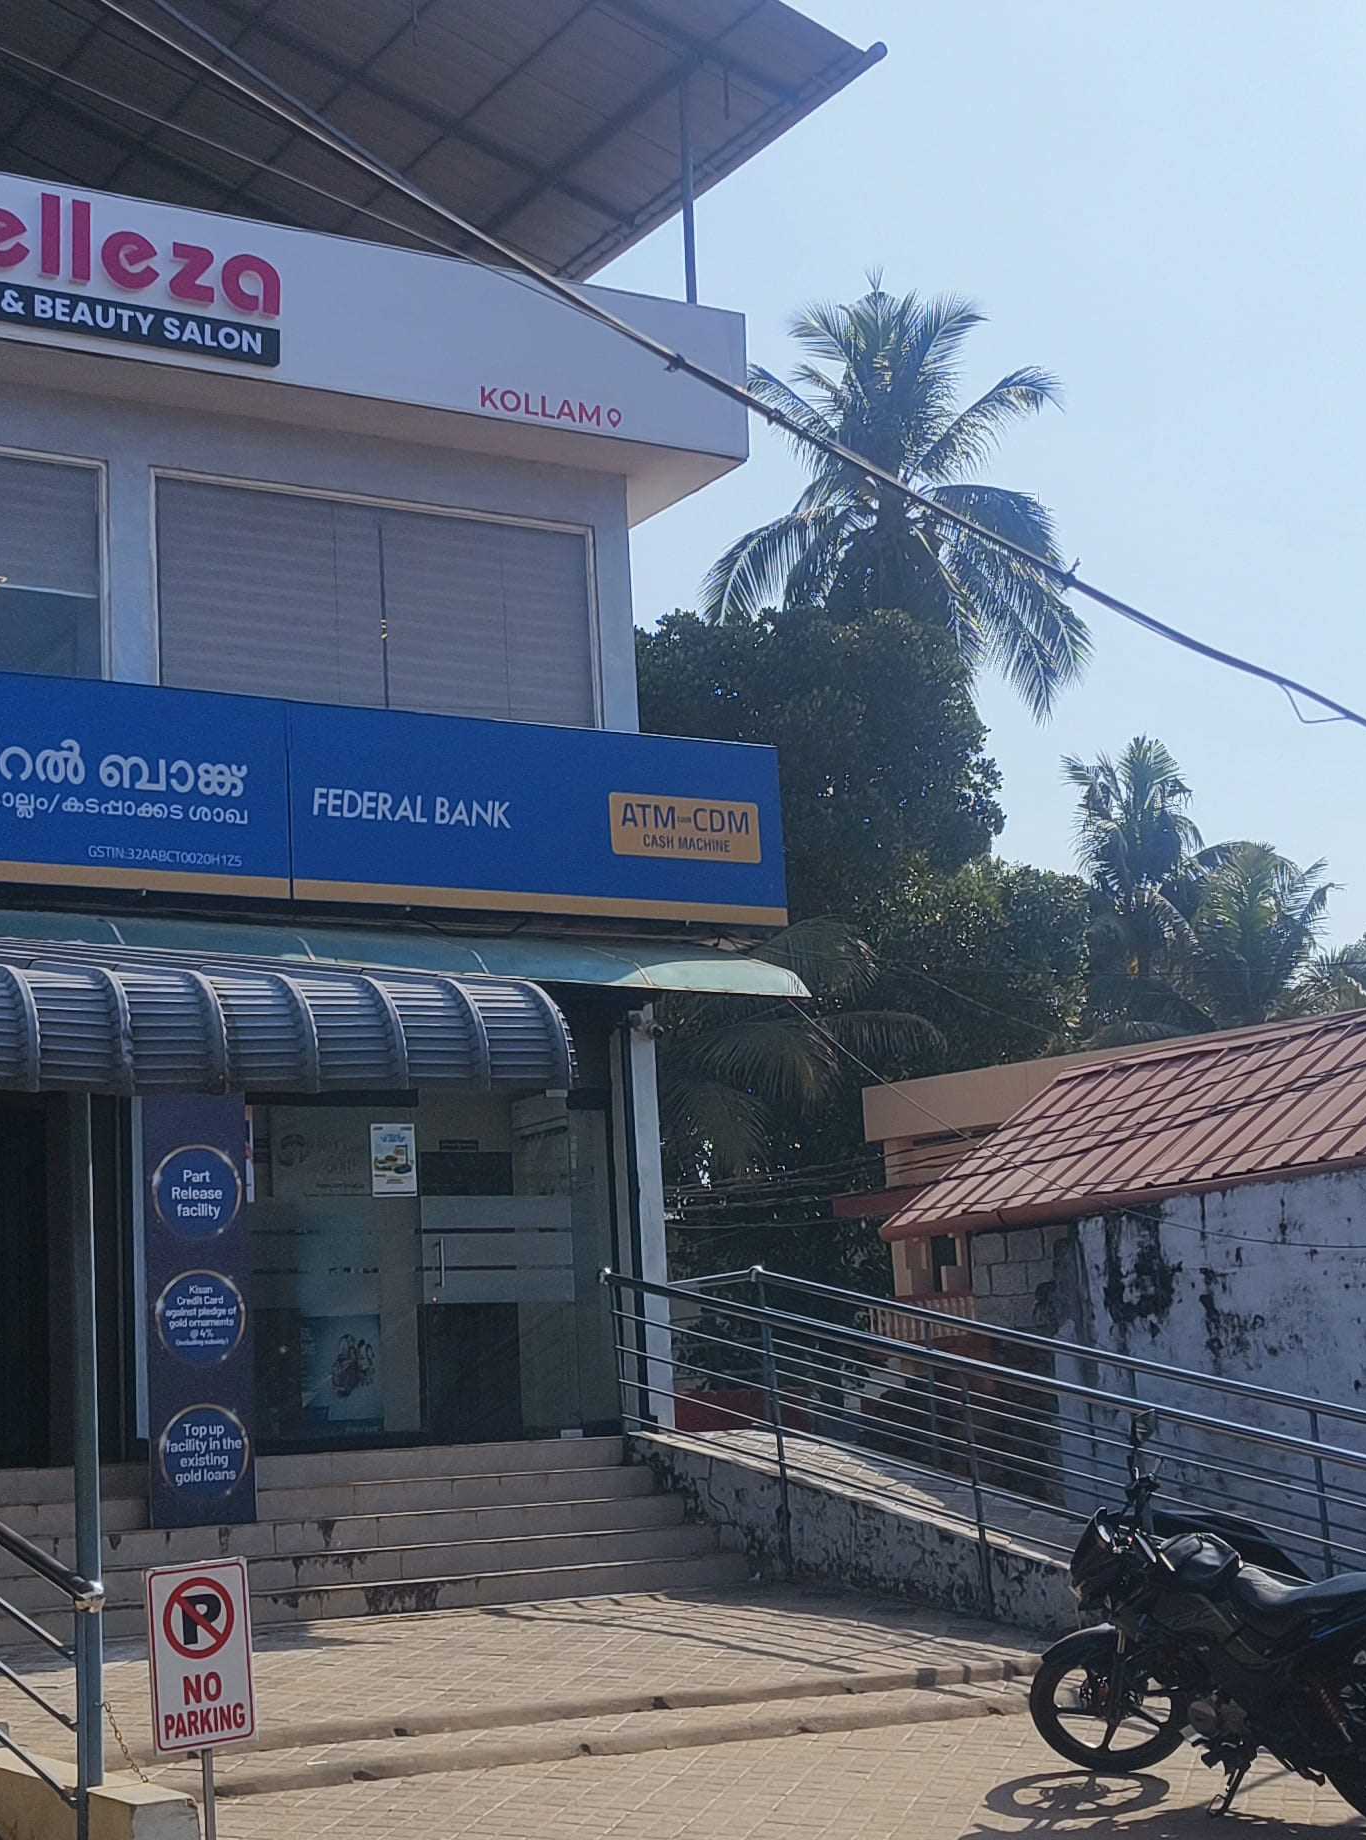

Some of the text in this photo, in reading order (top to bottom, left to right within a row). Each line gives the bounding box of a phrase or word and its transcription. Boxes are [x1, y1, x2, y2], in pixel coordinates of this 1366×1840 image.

[0, 288, 26, 316] &
[34, 294, 156, 338] BEAUTY
[163, 316, 263, 355] SALON
[480, 385, 601, 427] KOLLAM
[99, 754, 248, 798] ബാങ്ക്
[188, 806, 248, 825] ശാഖ
[312, 787, 511, 829] FEDERAL BANK
[621, 802, 750, 835] ATM CDM
[643, 834, 731, 852] CASH MACHINE
[183, 1169, 211, 1183] Part
[171, 1186, 223, 1200] Release
[177, 1203, 221, 1219] facility
[204, 1295, 224, 1305] Card
[168, 1317, 187, 1330] gold
[183, 1423, 225, 1438] Top up
[166, 1437, 242, 1454] facility in the
[180, 1453, 228, 1469] existing
[175, 1468, 236, 1486] gold loans
[182, 1671, 222, 1706] NO
[164, 1702, 245, 1740] PARKING
